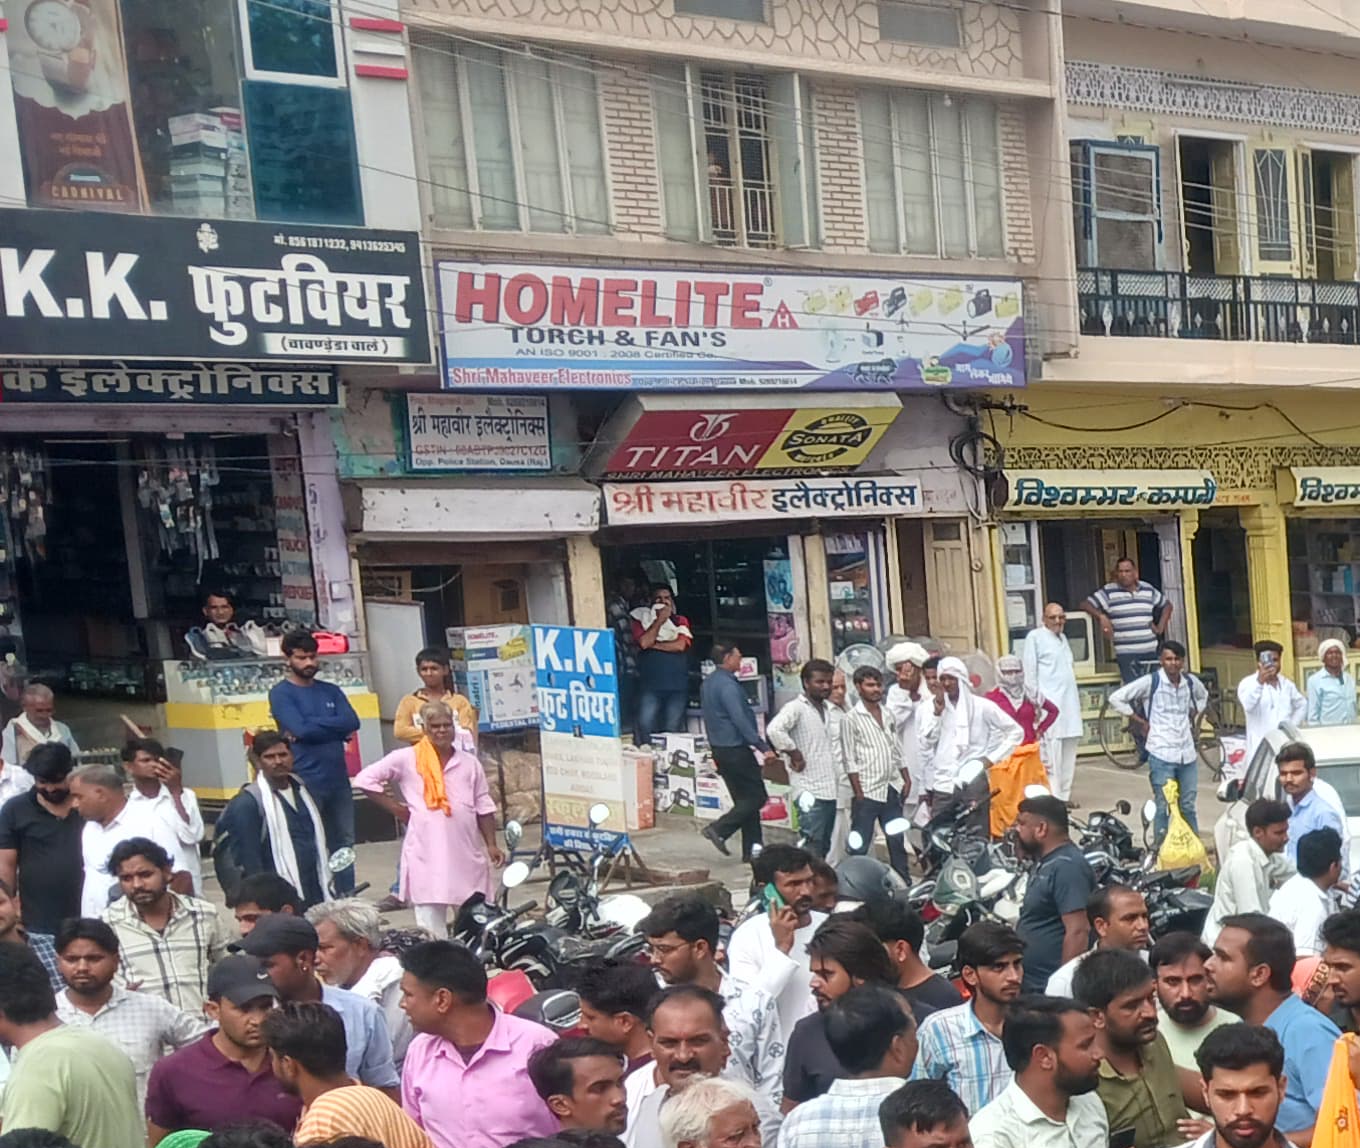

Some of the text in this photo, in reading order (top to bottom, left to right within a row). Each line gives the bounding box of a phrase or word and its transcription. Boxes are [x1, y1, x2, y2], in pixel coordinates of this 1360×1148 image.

[0, 247, 168, 321] K.K.
[187, 253, 412, 345] फुटवियर
[455, 271, 764, 330] HOMELITE
[503, 326, 727, 348] TORCH & FAN'S
[515, 348, 536, 357] AN
[540, 349, 564, 357] ISO
[567, 349, 599, 358] 9001
[609, 350, 641, 359] 2008
[452, 367, 482, 385] Shri
[485, 368, 555, 386] Mahaveer
[557, 369, 632, 386] Electronics
[412, 406, 427, 434] श्री
[430, 406, 473, 438] महावीर
[789, 429, 866, 447] SONATA
[625, 444, 760, 469] TITAN
[613, 485, 654, 514] श्री
[659, 482, 768, 513] महावीर
[534, 627, 614, 676] K.K.
[537, 680, 618, 731] फुट वियर
